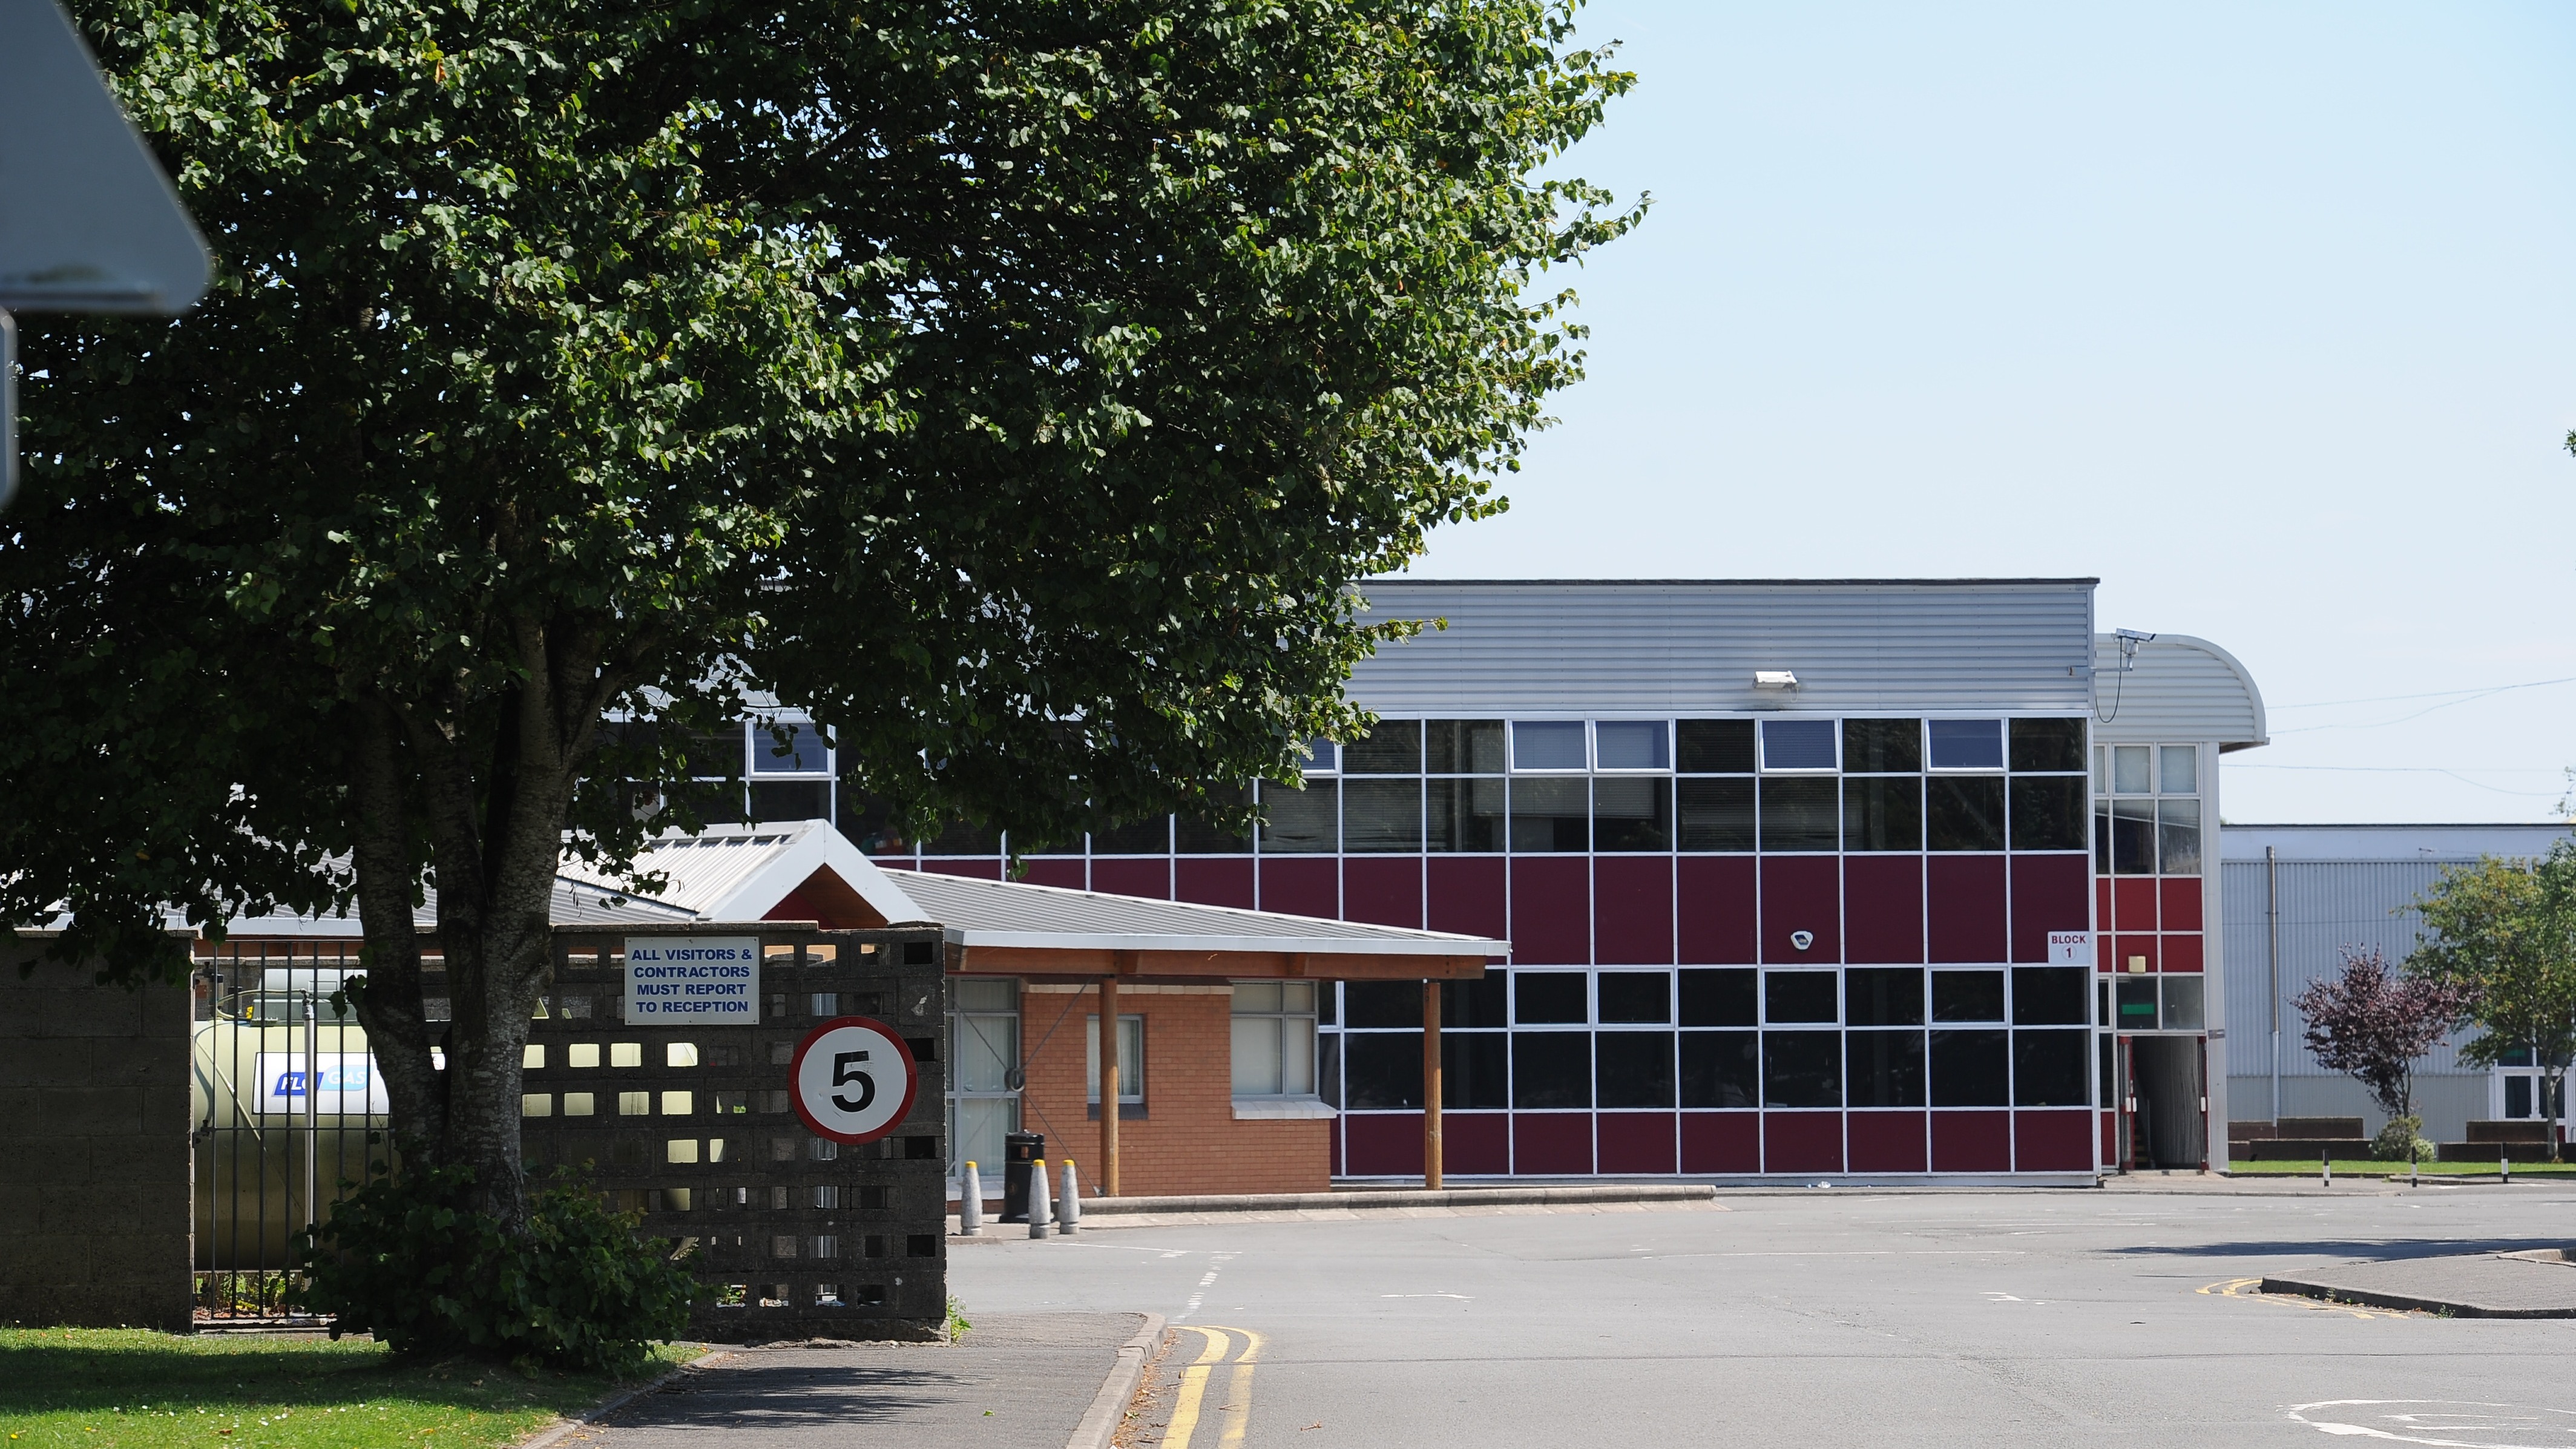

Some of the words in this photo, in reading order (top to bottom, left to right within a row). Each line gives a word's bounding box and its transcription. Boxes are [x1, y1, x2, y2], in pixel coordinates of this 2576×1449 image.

[2051, 935, 2086, 944] BLOCK
[631, 948, 661, 961] ALL
[665, 948, 736, 961] VISITORS
[741, 948, 752, 960] &
[2066, 947, 2071, 958] 1
[634, 966, 750, 978] CONTRACTORS
[637, 984, 680, 996] MUST
[685, 984, 747, 996] REPORT
[636, 1000, 657, 1013] TO
[662, 1000, 748, 1013] RECEPTION
[832, 1050, 875, 1112] 5
